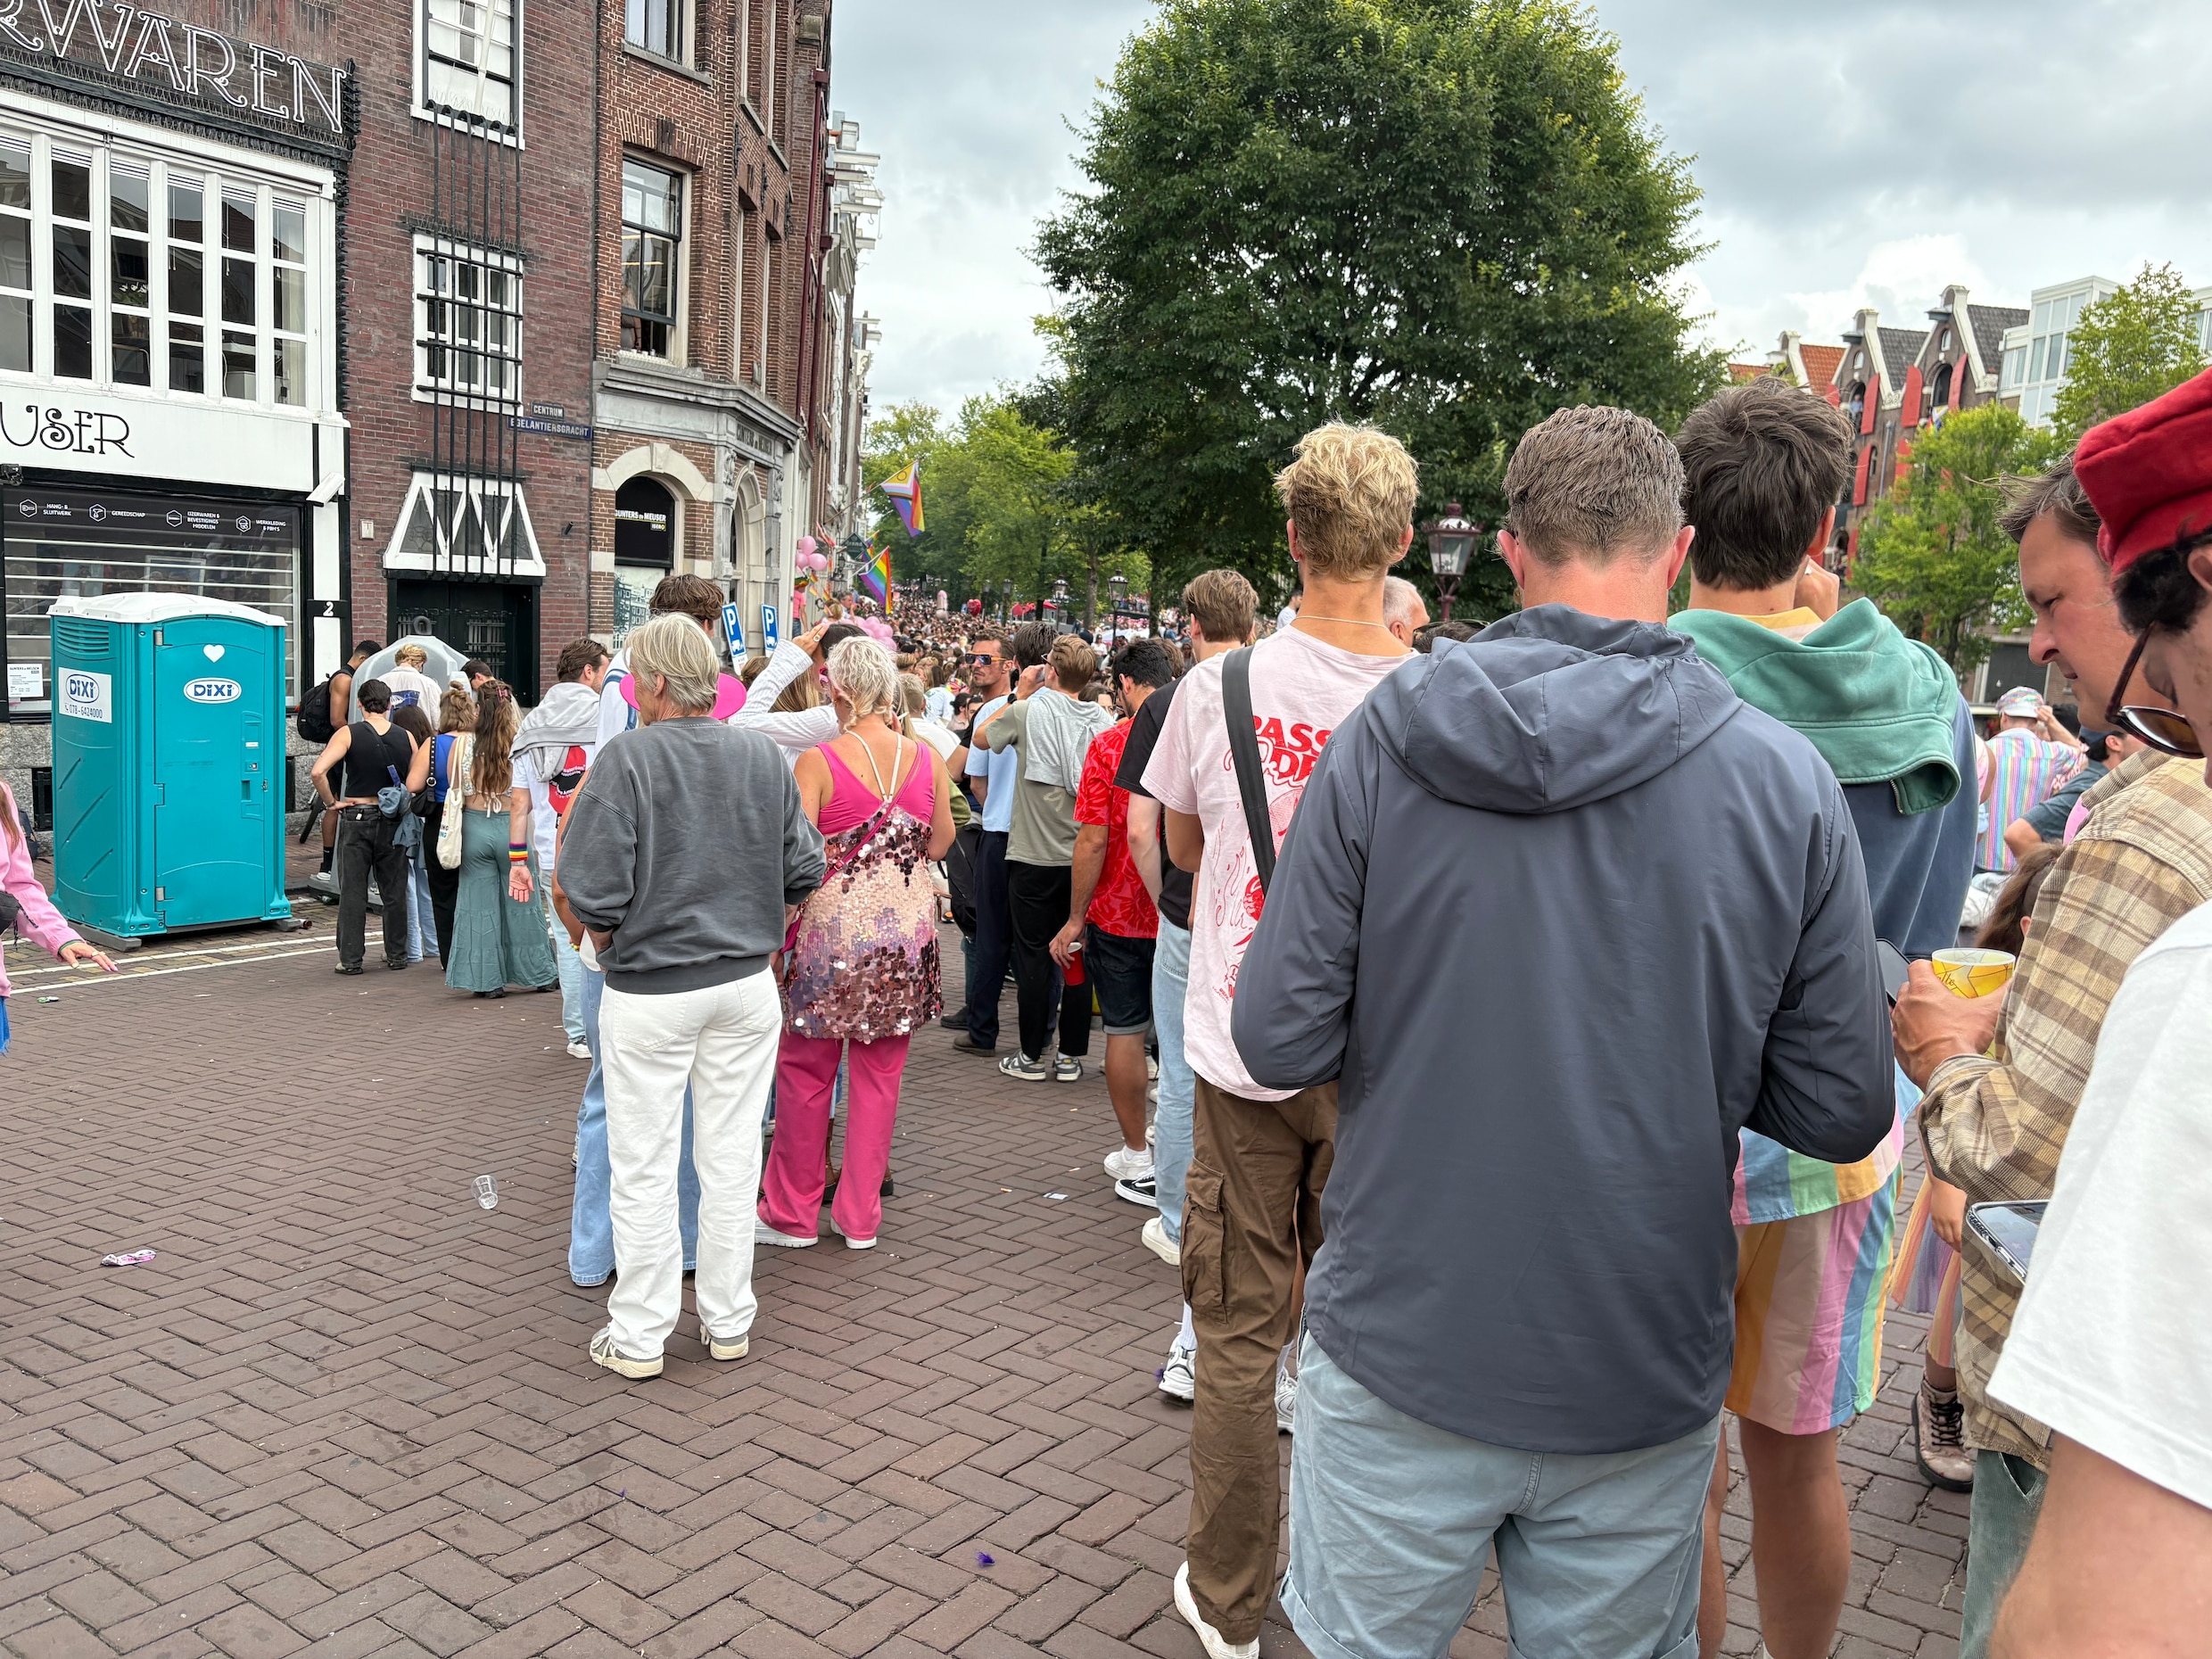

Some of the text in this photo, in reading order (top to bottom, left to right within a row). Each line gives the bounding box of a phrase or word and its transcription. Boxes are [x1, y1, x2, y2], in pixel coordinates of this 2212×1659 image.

[533, 405, 564, 417] CENTRUM
[0, 401, 135, 458] USER
[255, 519, 286, 527] WERKKLEDING
[643, 512, 666, 522] MEUSER
[323, 601, 334, 617] 2
[725, 608, 737, 636] P
[764, 608, 774, 632] P
